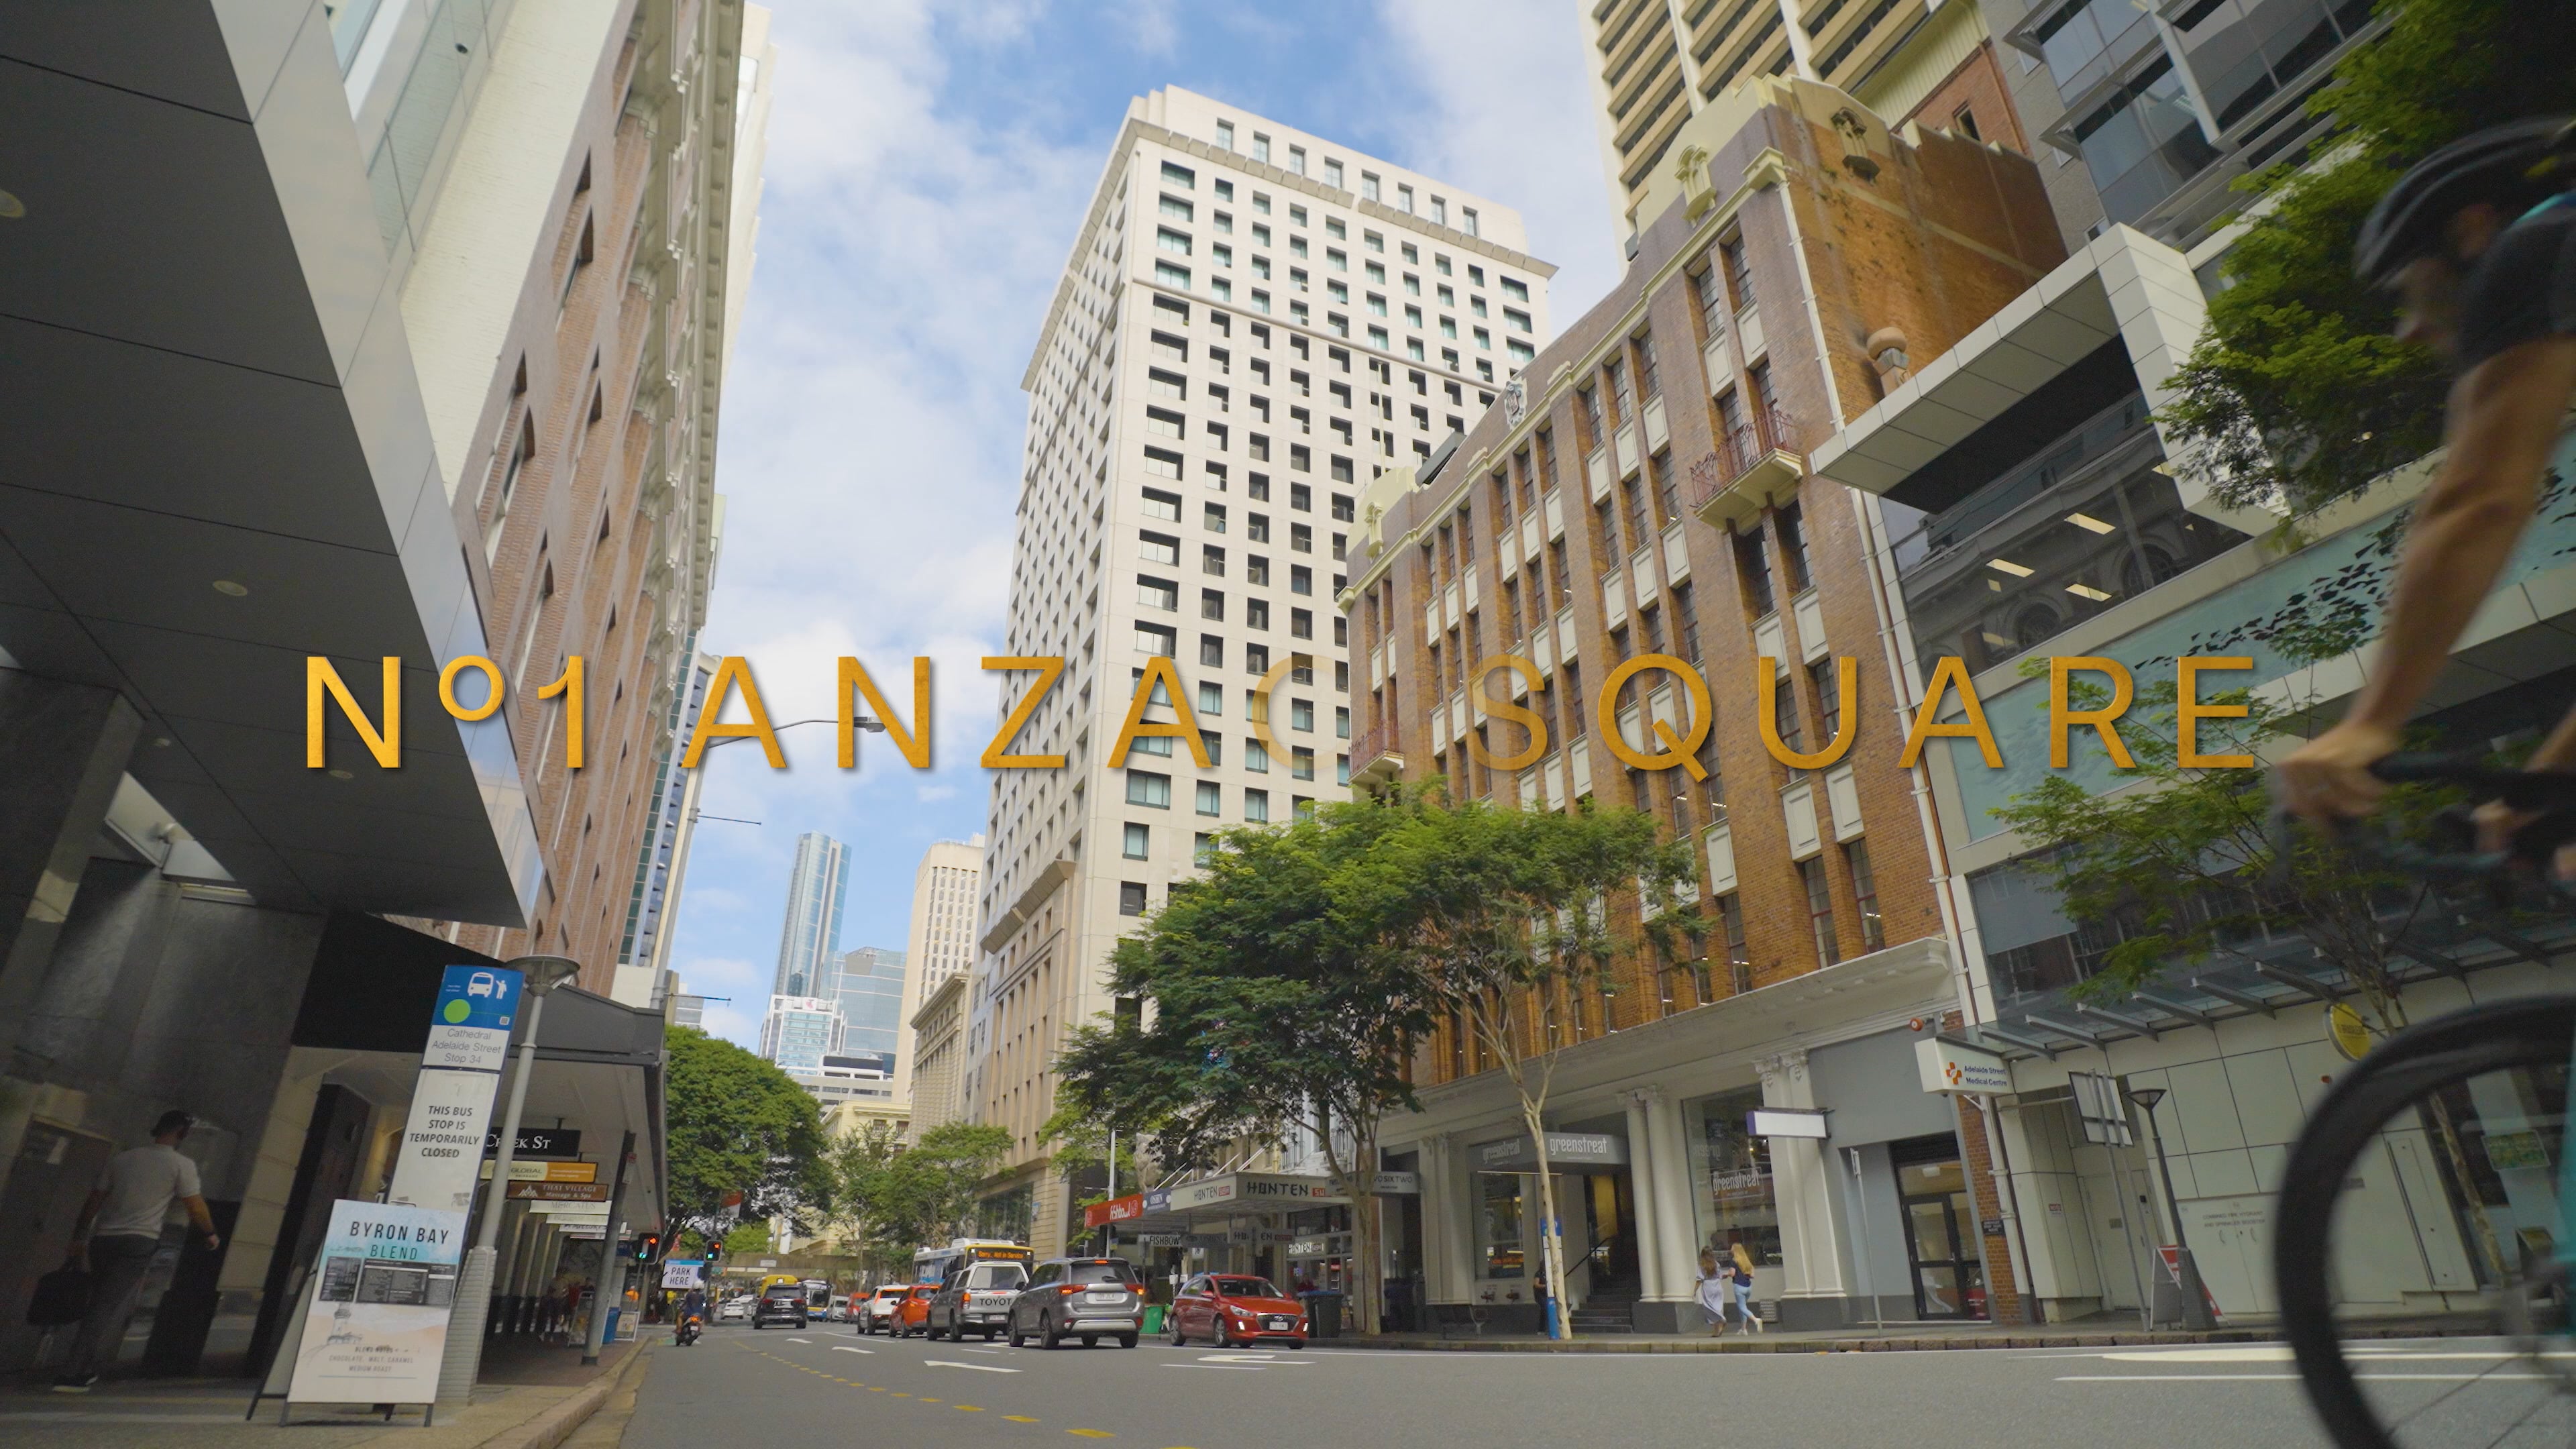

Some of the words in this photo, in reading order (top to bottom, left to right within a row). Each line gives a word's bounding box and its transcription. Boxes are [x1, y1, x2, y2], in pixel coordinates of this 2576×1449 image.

[447, 1028, 492, 1040] Cathedral
[431, 1040, 470, 1051] Adelaide
[473, 1042, 501, 1053] Street
[444, 1053, 466, 1064] Stop
[470, 1055, 481, 1063] 34
[1964, 1065, 1988, 1073] Adelaide
[428, 1106, 450, 1116] THIS
[453, 1107, 473, 1117] BUS
[428, 1120, 453, 1130] STOP
[456, 1121, 466, 1130] IS
[410, 1133, 480, 1145] TEMPORARILY
[486, 1134, 528, 1148] CEK
[1550, 1137, 1607, 1156] greenstreat
[421, 1148, 460, 1158] CLOSED
[1712, 1170, 1760, 1195] greenstreat
[350, 1221, 409, 1240] BYRON
[416, 1228, 449, 1244] BAY
[1149, 1235, 1180, 1246] FISHBOW
[370, 1244, 419, 1260] BLEND
[672, 1267, 691, 1275] PARK
[669, 1277, 689, 1285] HERE
[979, 1298, 1012, 1307] TOYOT
